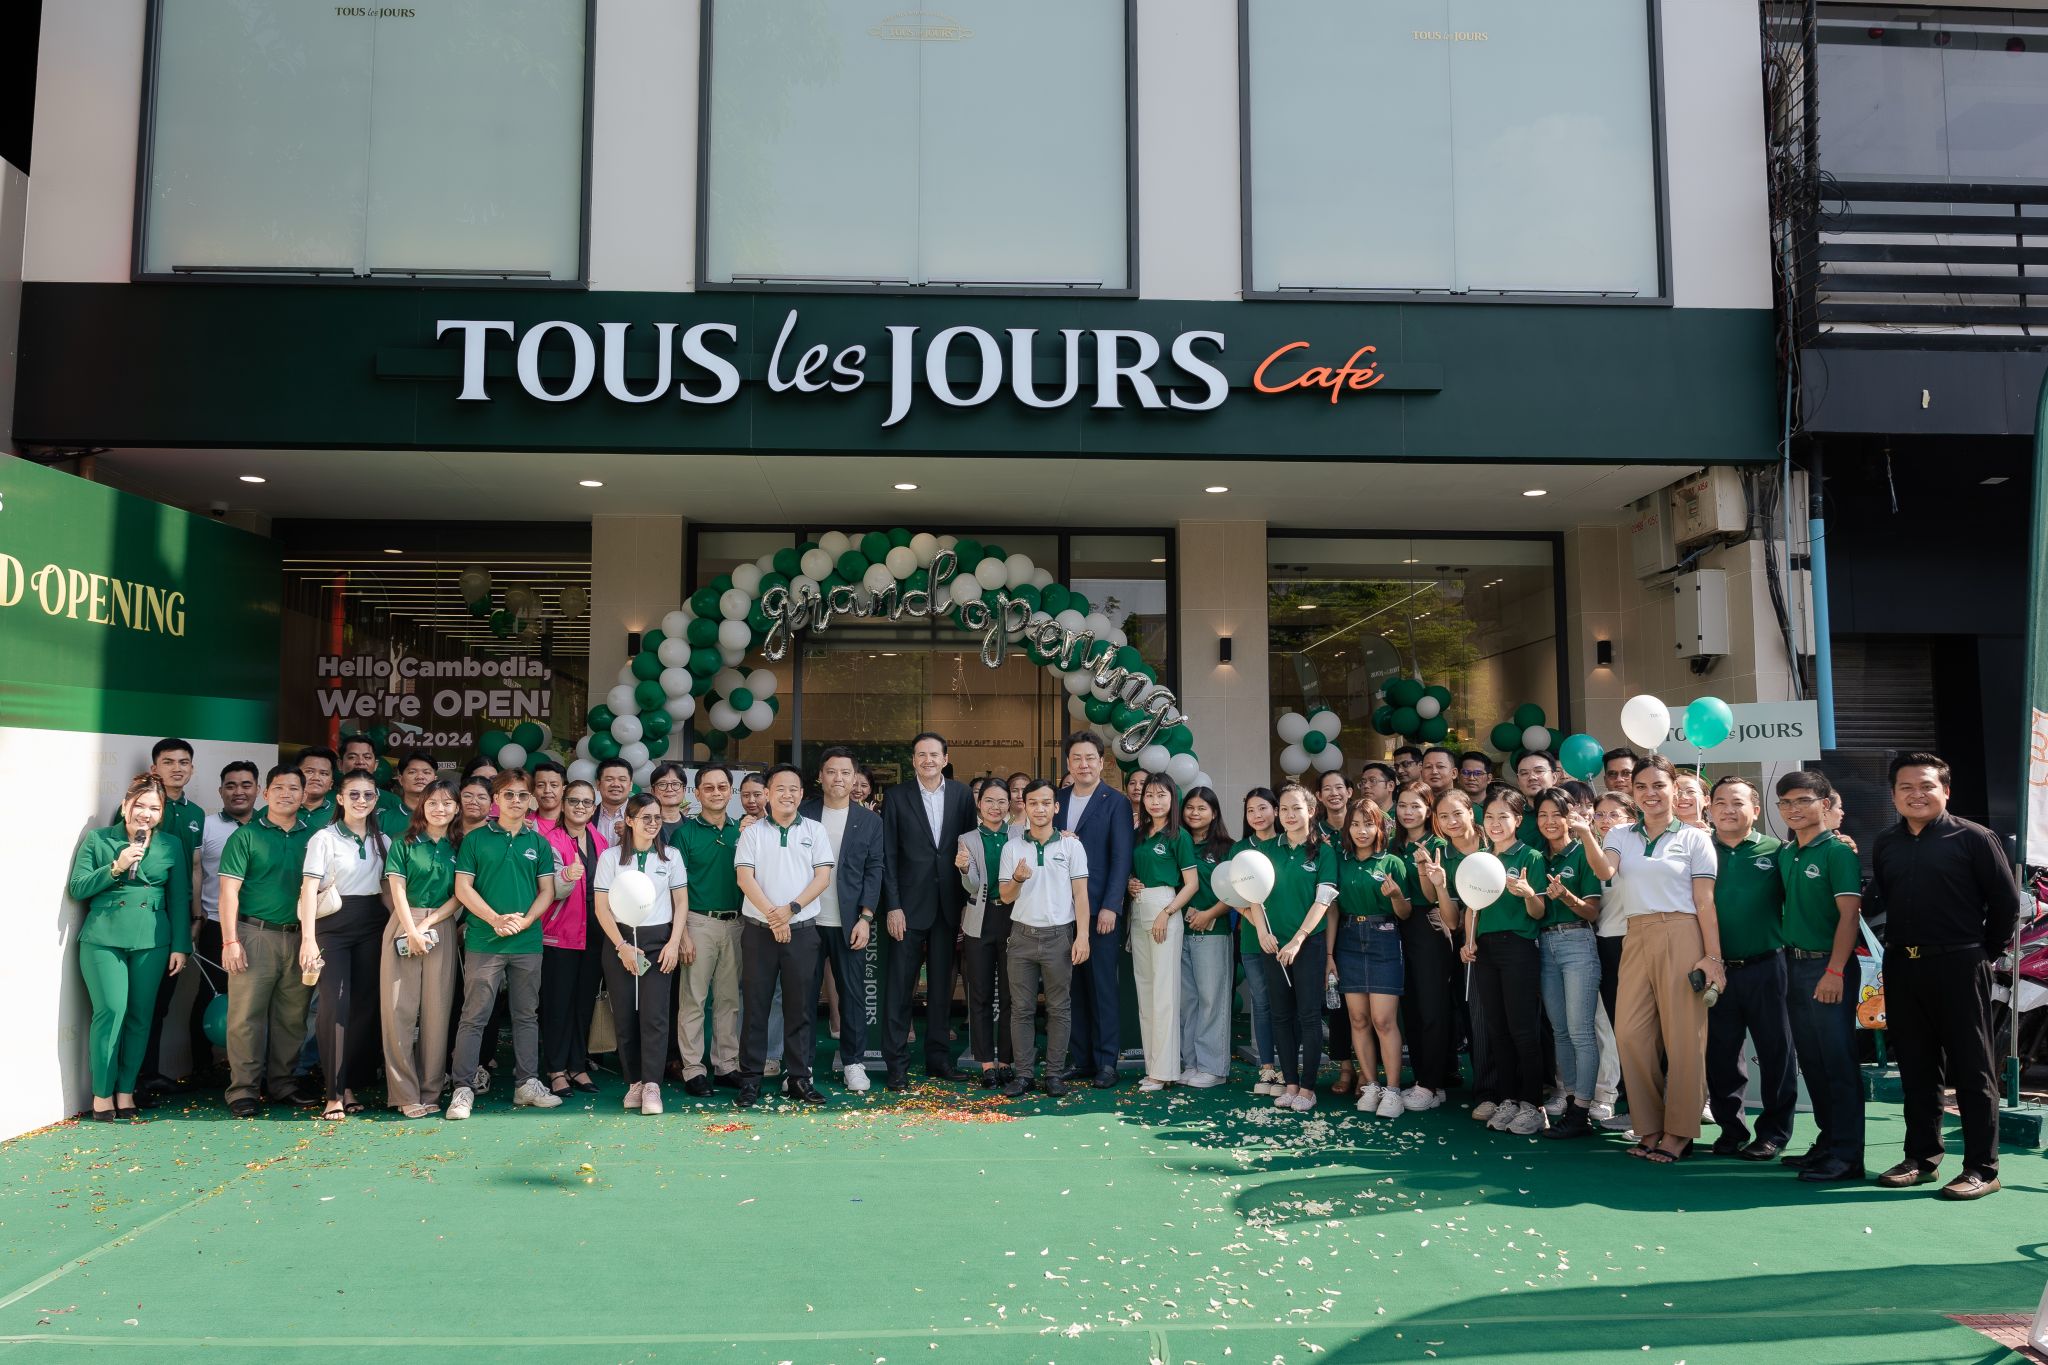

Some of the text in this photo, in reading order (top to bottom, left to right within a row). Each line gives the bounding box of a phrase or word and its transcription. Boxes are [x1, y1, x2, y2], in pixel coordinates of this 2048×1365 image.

[335, 7, 416, 19] TOUS les JOURS
[1413, 31, 1442, 41] TOUS
[1454, 31, 1489, 42] JOURS
[436, 309, 1386, 429] TOUS les JOURS Café
[30, 563, 186, 637] OPENING
[761, 549, 1188, 754] grand opening
[318, 656, 552, 681] Hello Cambodia,
[317, 689, 551, 717] We're OPEN!
[388, 732, 473, 748] 04.2024
[973, 739, 991, 747] GIFT
[992, 739, 1025, 748] SECTION
[1665, 727, 1687, 742] TO
[1739, 722, 1803, 743] JOURS
[866, 963, 878, 978] les
[863, 979, 878, 1026] JOURS
